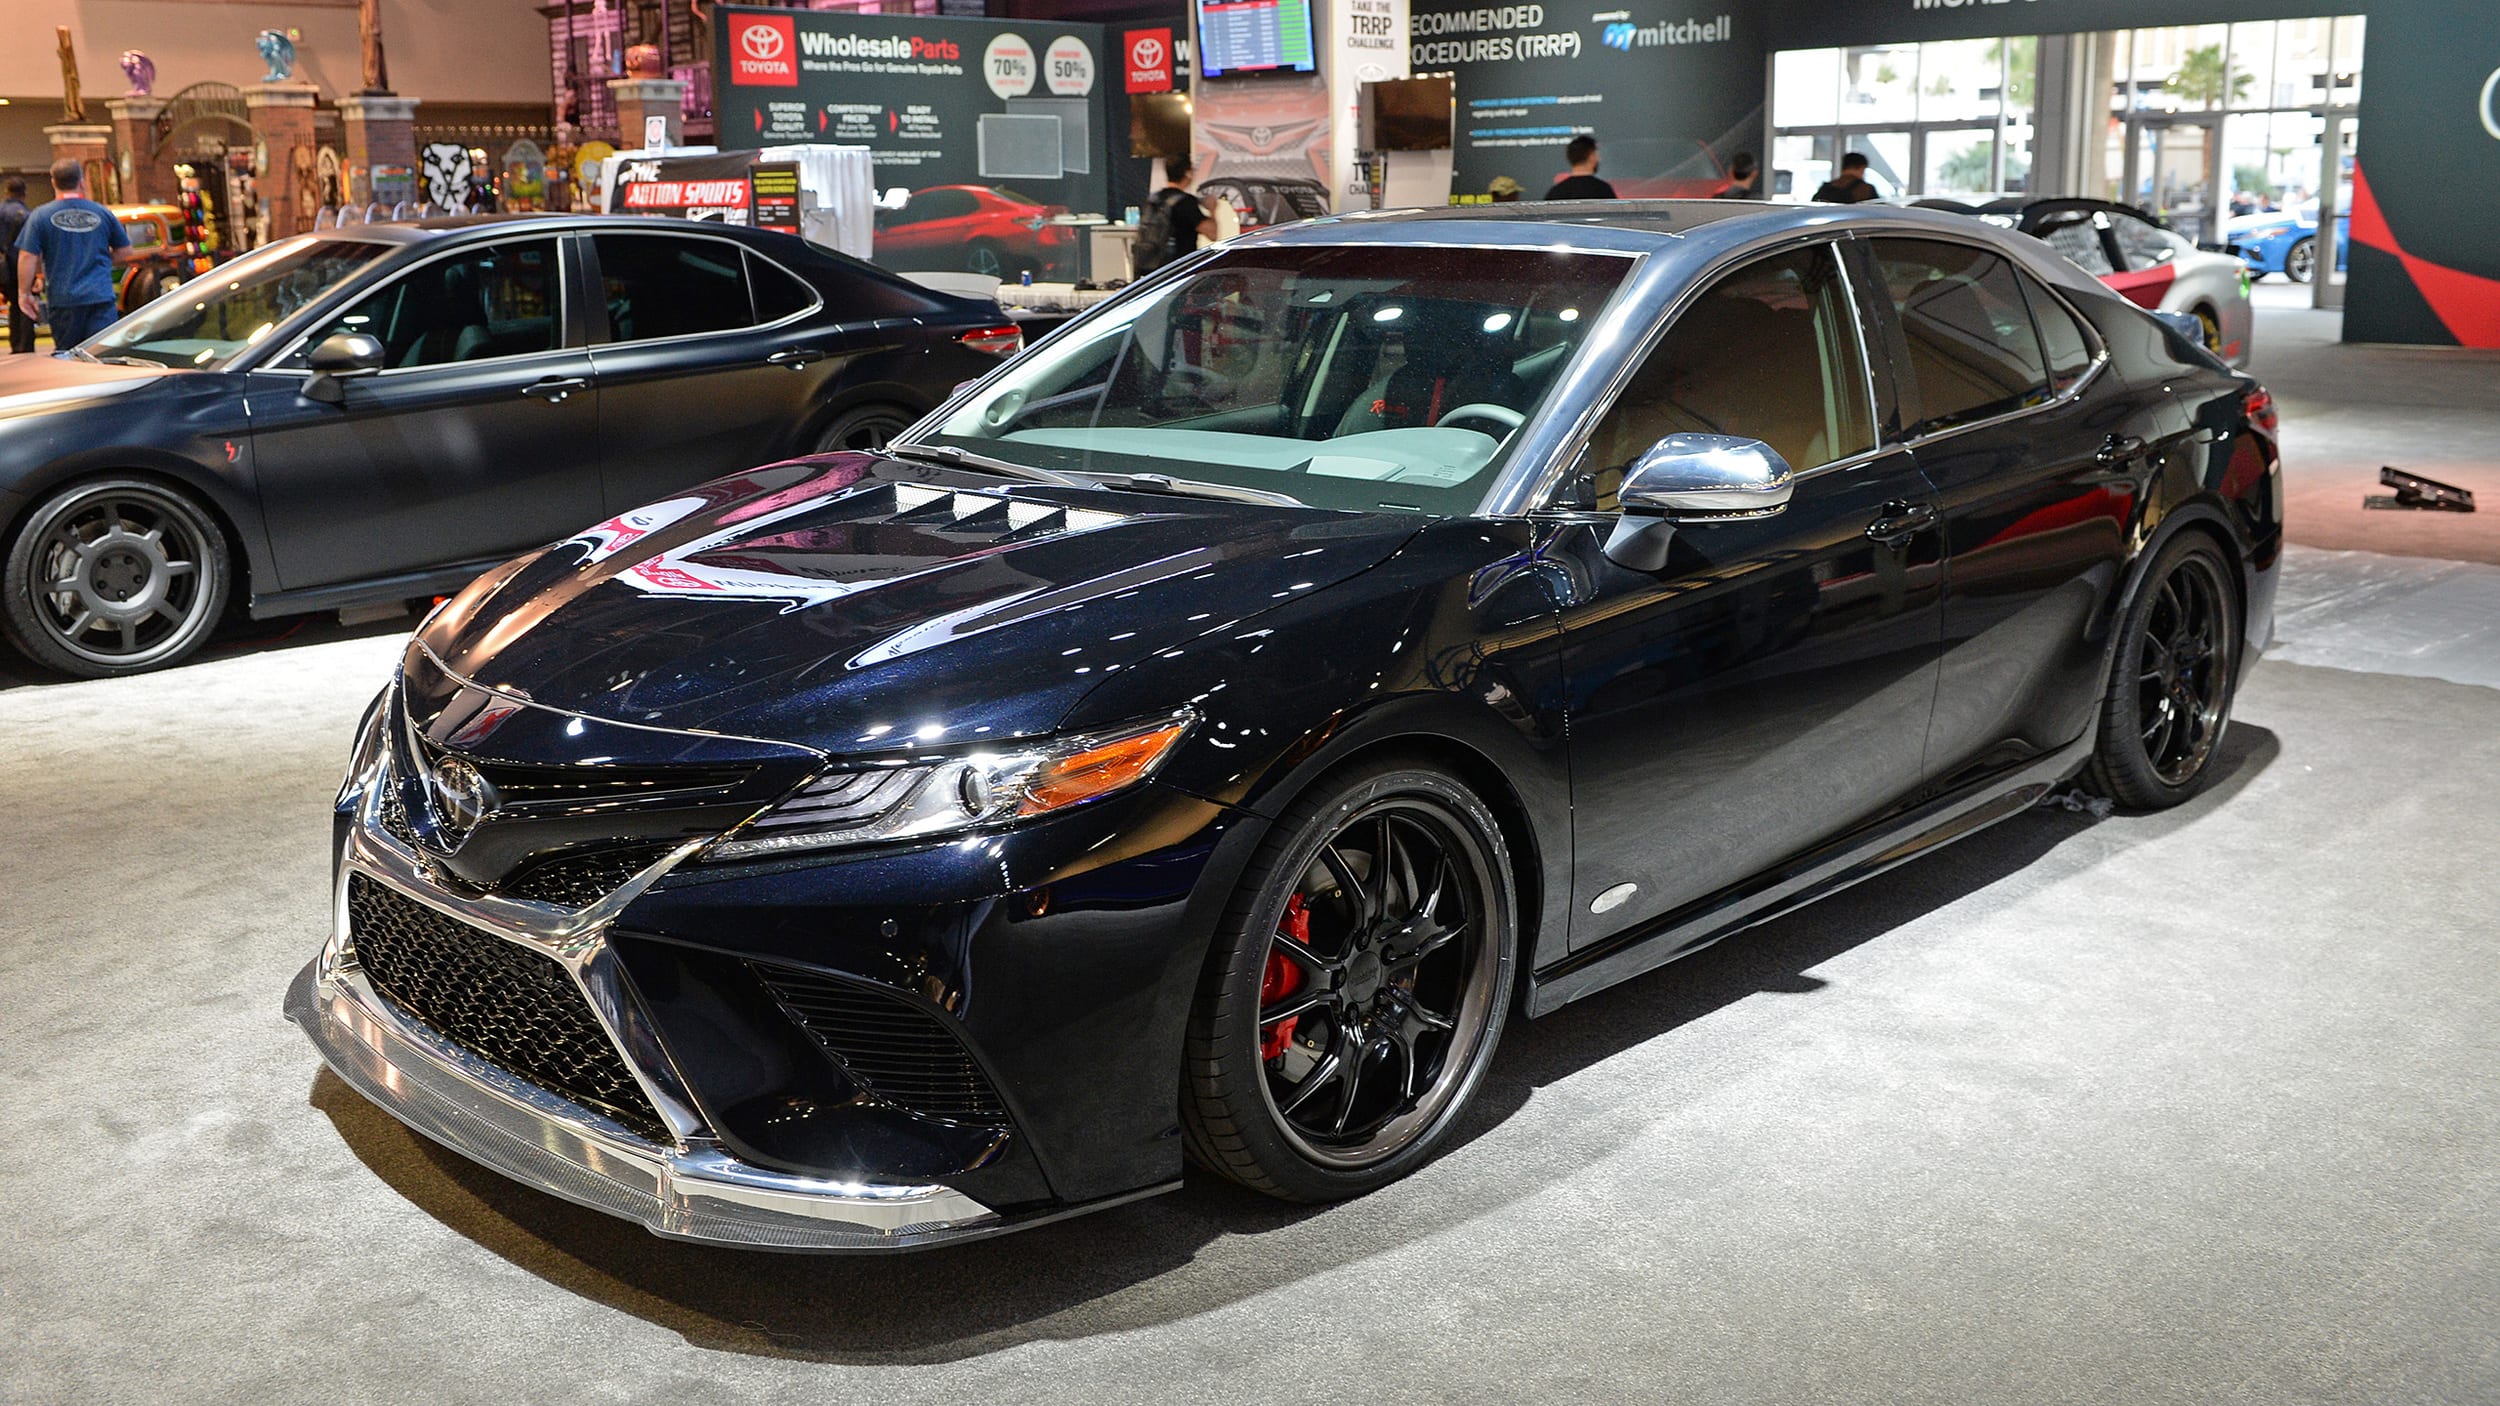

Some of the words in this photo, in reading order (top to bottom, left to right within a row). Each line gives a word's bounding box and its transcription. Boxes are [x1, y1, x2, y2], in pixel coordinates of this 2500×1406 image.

[1351, 15, 1392, 35] TRRP
[1410, 4, 1543, 36] ECOMMENDED
[1637, 15, 1731, 47] mitchell
[1347, 36, 1394, 50] CHALLENGE
[1410, 37, 1514, 66] OCEDURES
[1516, 31, 1581, 62] (TRRP)
[740, 60, 789, 74] TOYOTA
[994, 58, 1027, 76] 70%
[1055, 60, 1086, 78] 50%
[1131, 70, 1166, 83] TOYOTA
[627, 182, 683, 204] ACTION
[683, 180, 744, 204] SPORTS
